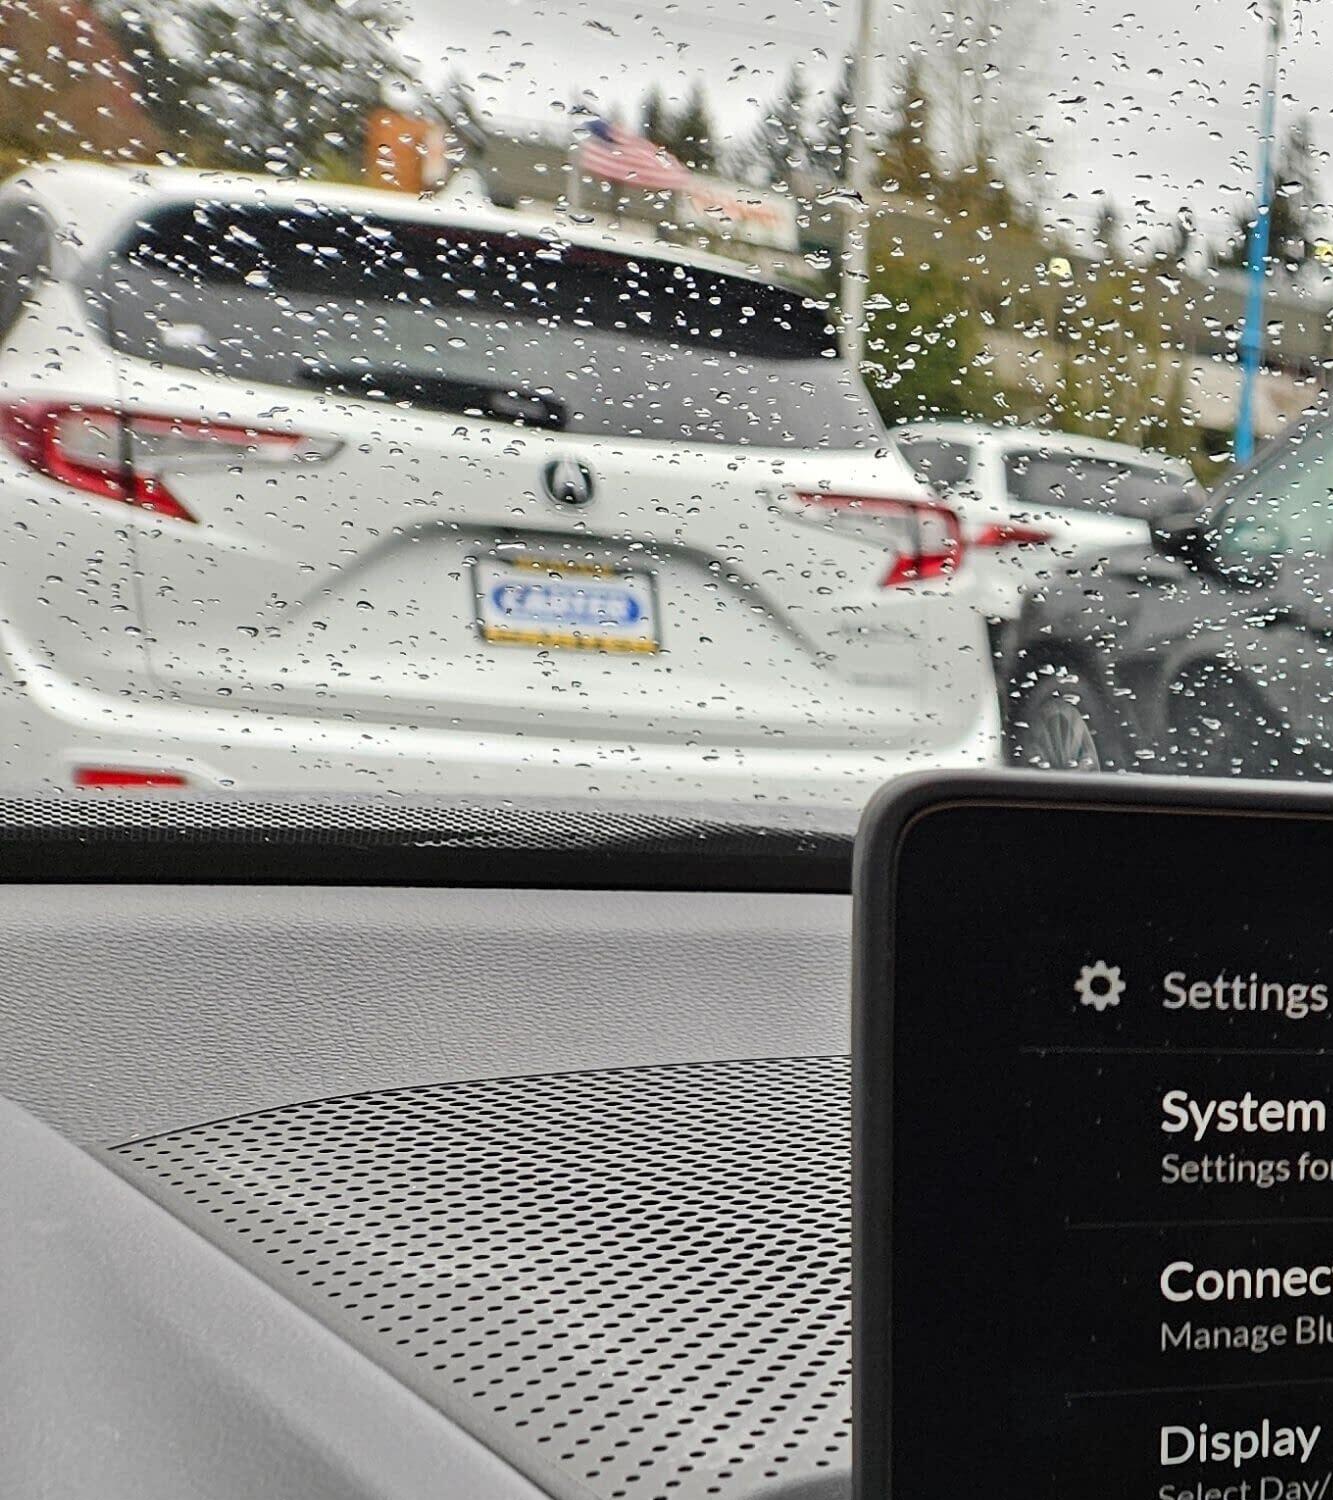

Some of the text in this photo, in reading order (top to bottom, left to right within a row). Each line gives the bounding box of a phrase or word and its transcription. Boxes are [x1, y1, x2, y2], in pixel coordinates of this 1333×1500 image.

[1161, 970, 1330, 1021] Settings
[1160, 1089, 1327, 1142] System
[1160, 1151, 1291, 1190] Settings
[1160, 1320, 1288, 1354] Manage
[1159, 1417, 1322, 1469] Display
